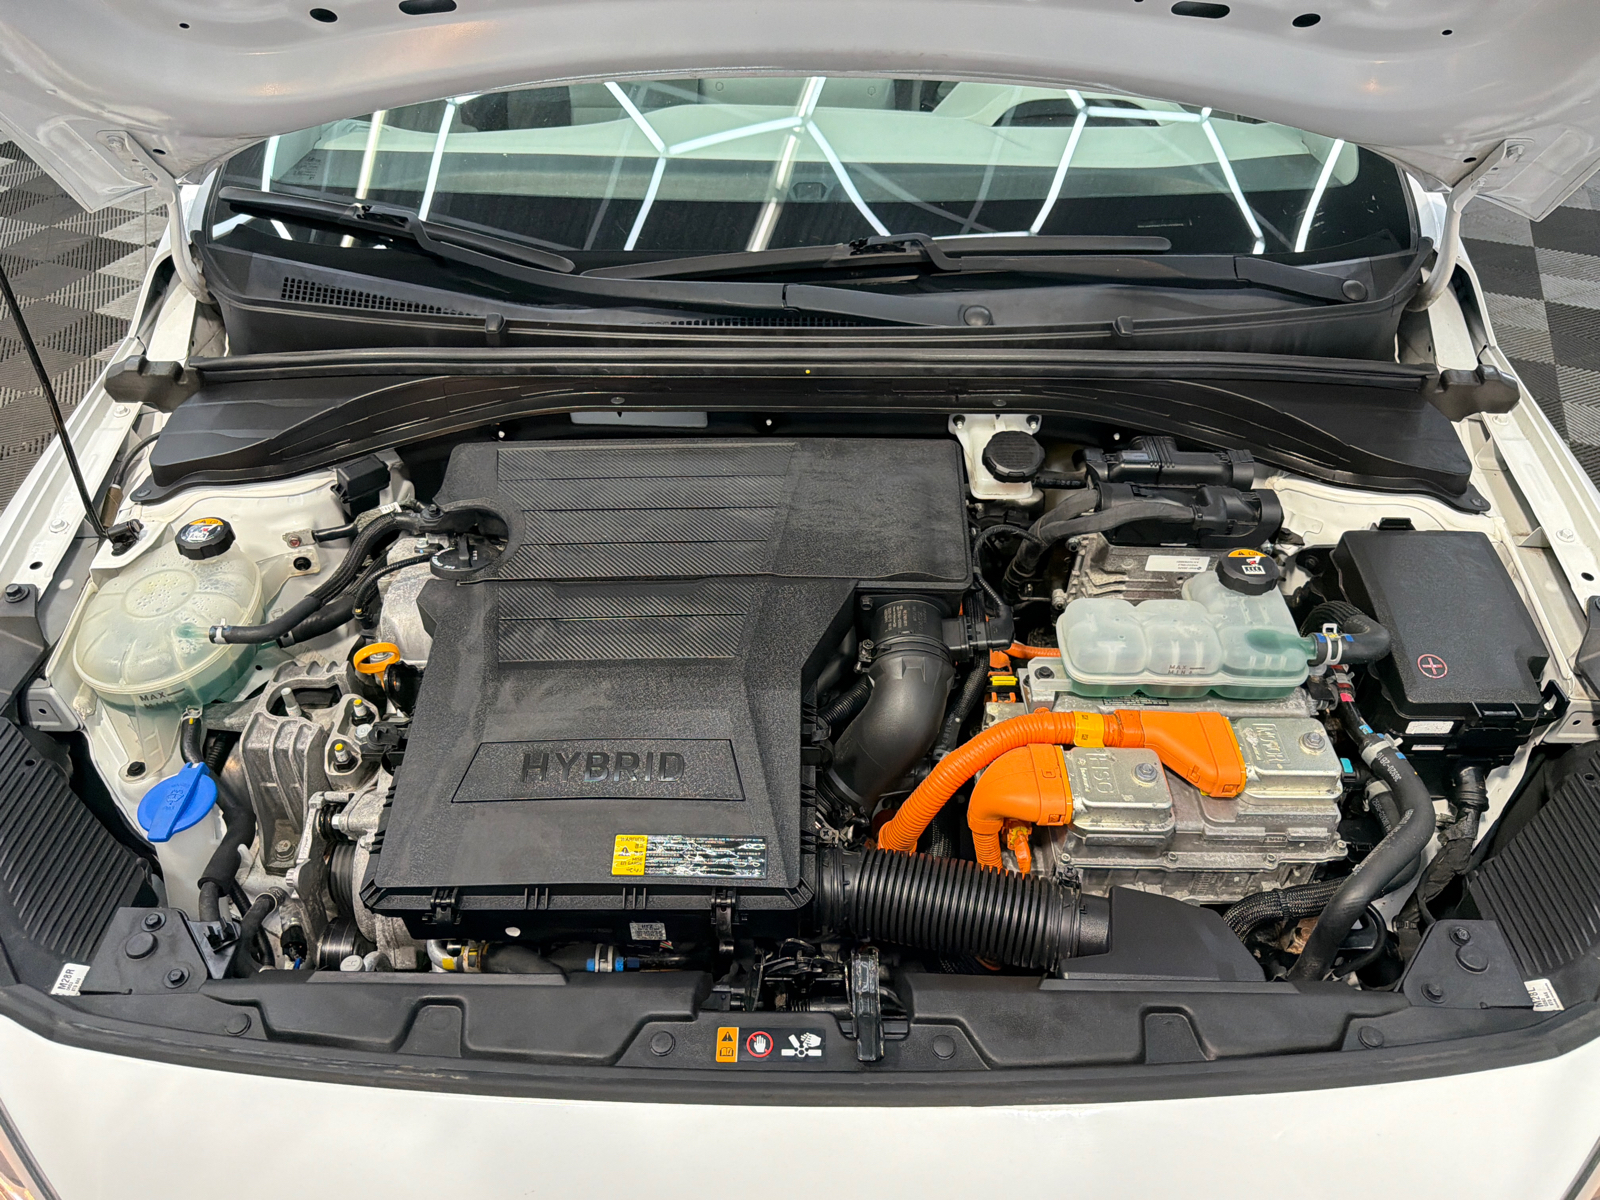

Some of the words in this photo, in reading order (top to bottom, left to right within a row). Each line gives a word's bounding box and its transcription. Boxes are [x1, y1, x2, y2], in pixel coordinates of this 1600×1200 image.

[139, 691, 166, 702] MAX
[520, 751, 685, 782] HYBRID
[57, 968, 75, 990] M28R
